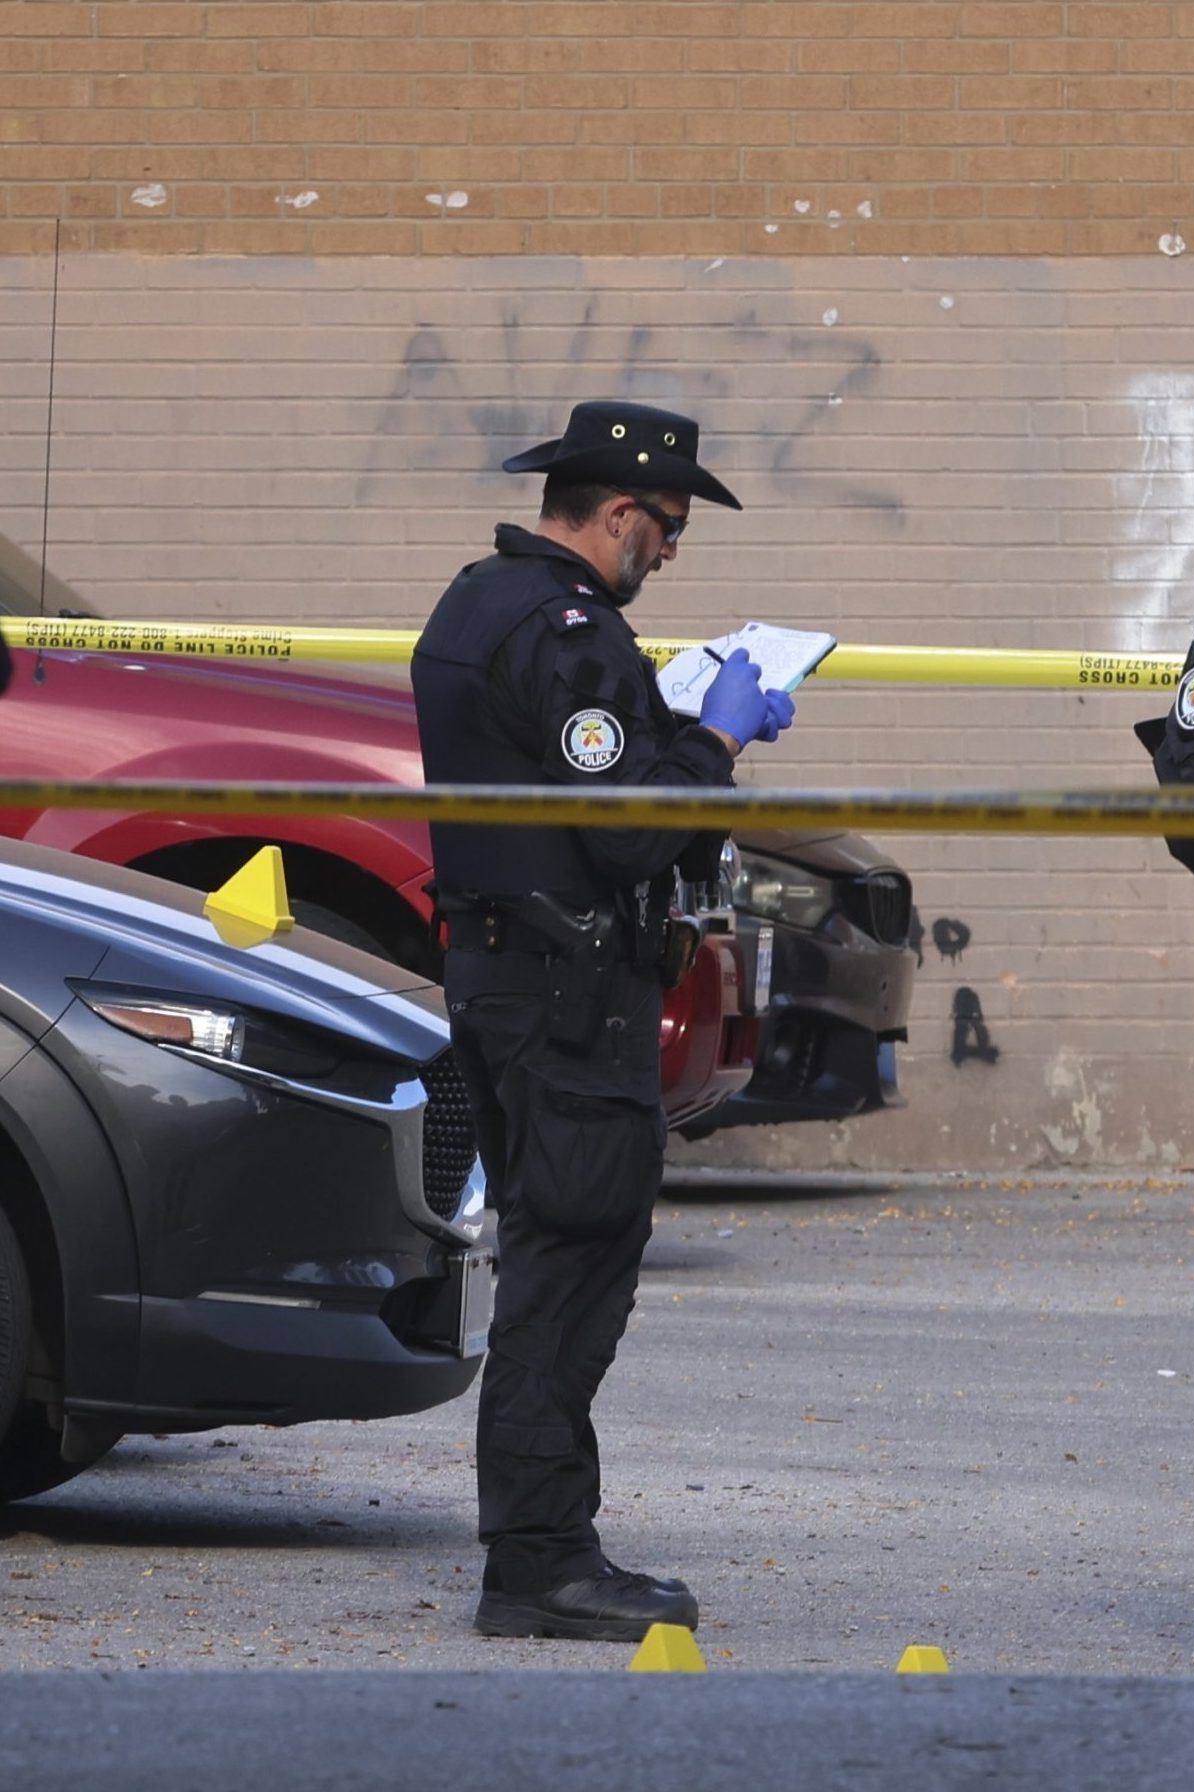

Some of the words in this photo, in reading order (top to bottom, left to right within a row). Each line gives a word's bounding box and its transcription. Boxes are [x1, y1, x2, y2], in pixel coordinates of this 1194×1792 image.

[25, 637, 86, 648] CROSS
[96, 638, 131, 650] NOT
[140, 640, 164, 651] DO
[174, 642, 215, 654] LINE
[225, 643, 291, 656] POLICE
[1079, 671, 1139, 684] CROSS
[578, 751, 612, 767] POLICE
